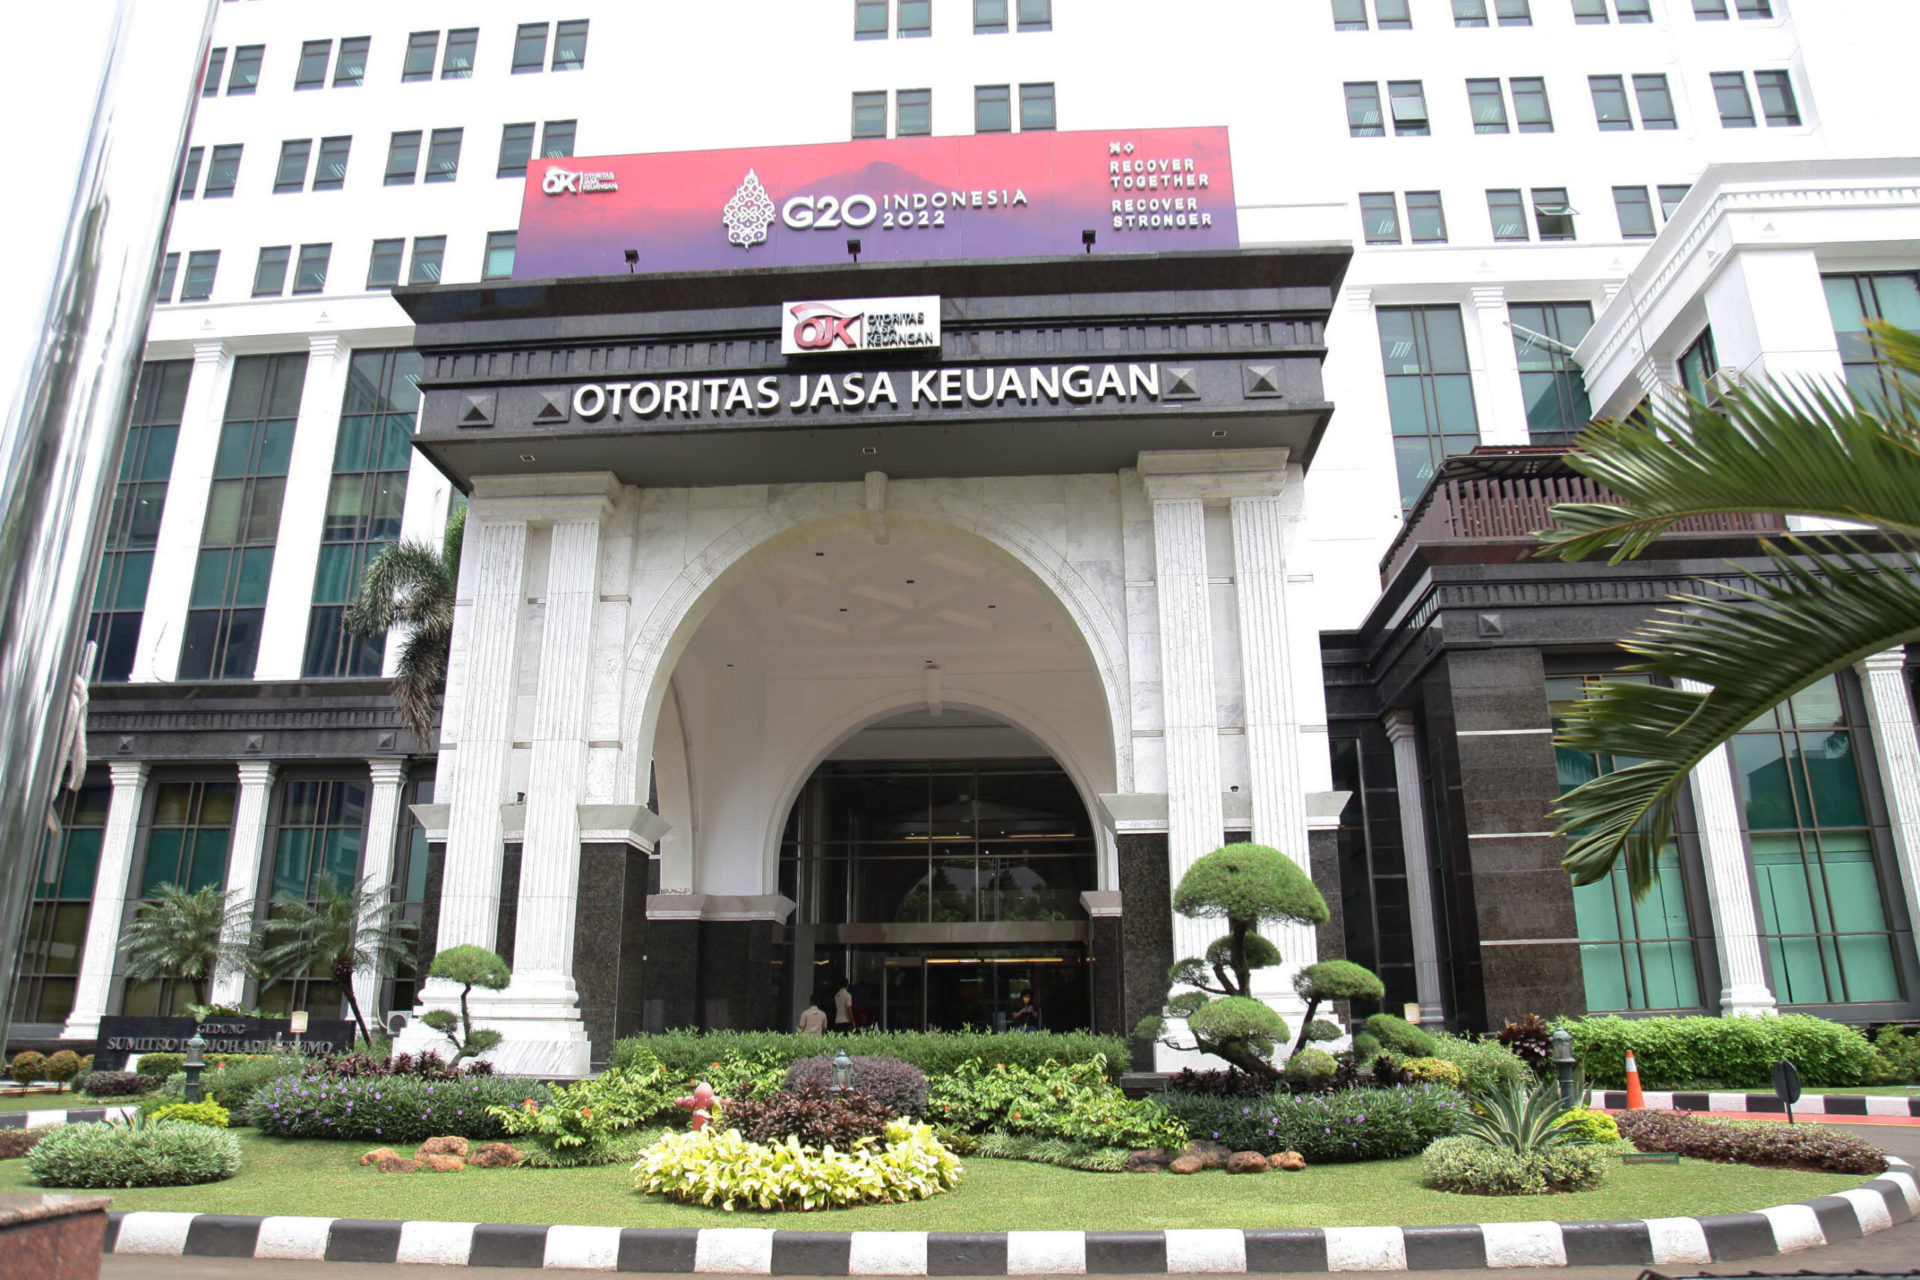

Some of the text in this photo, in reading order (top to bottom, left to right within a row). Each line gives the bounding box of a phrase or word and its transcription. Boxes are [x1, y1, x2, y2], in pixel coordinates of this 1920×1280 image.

[1109, 158, 1194, 174] RECOVER
[1110, 173, 1209, 189] TOGETHER
[883, 189, 1028, 210] INDONESIA
[1111, 197, 1197, 213] RECOVER
[782, 193, 878, 231] G20
[883, 210, 945, 230] 2022
[1113, 213, 1212, 230] STRONGER
[867, 312, 924, 326] OTORITAS
[868, 324, 896, 335] JASA
[867, 332, 933, 347] KEUANGAN
[573, 363, 1160, 419] OTORITAS JASA KEUANGAN
[197, 1023, 247, 1034] GEDUNG
[107, 1037, 178, 1051] SUMITRO
